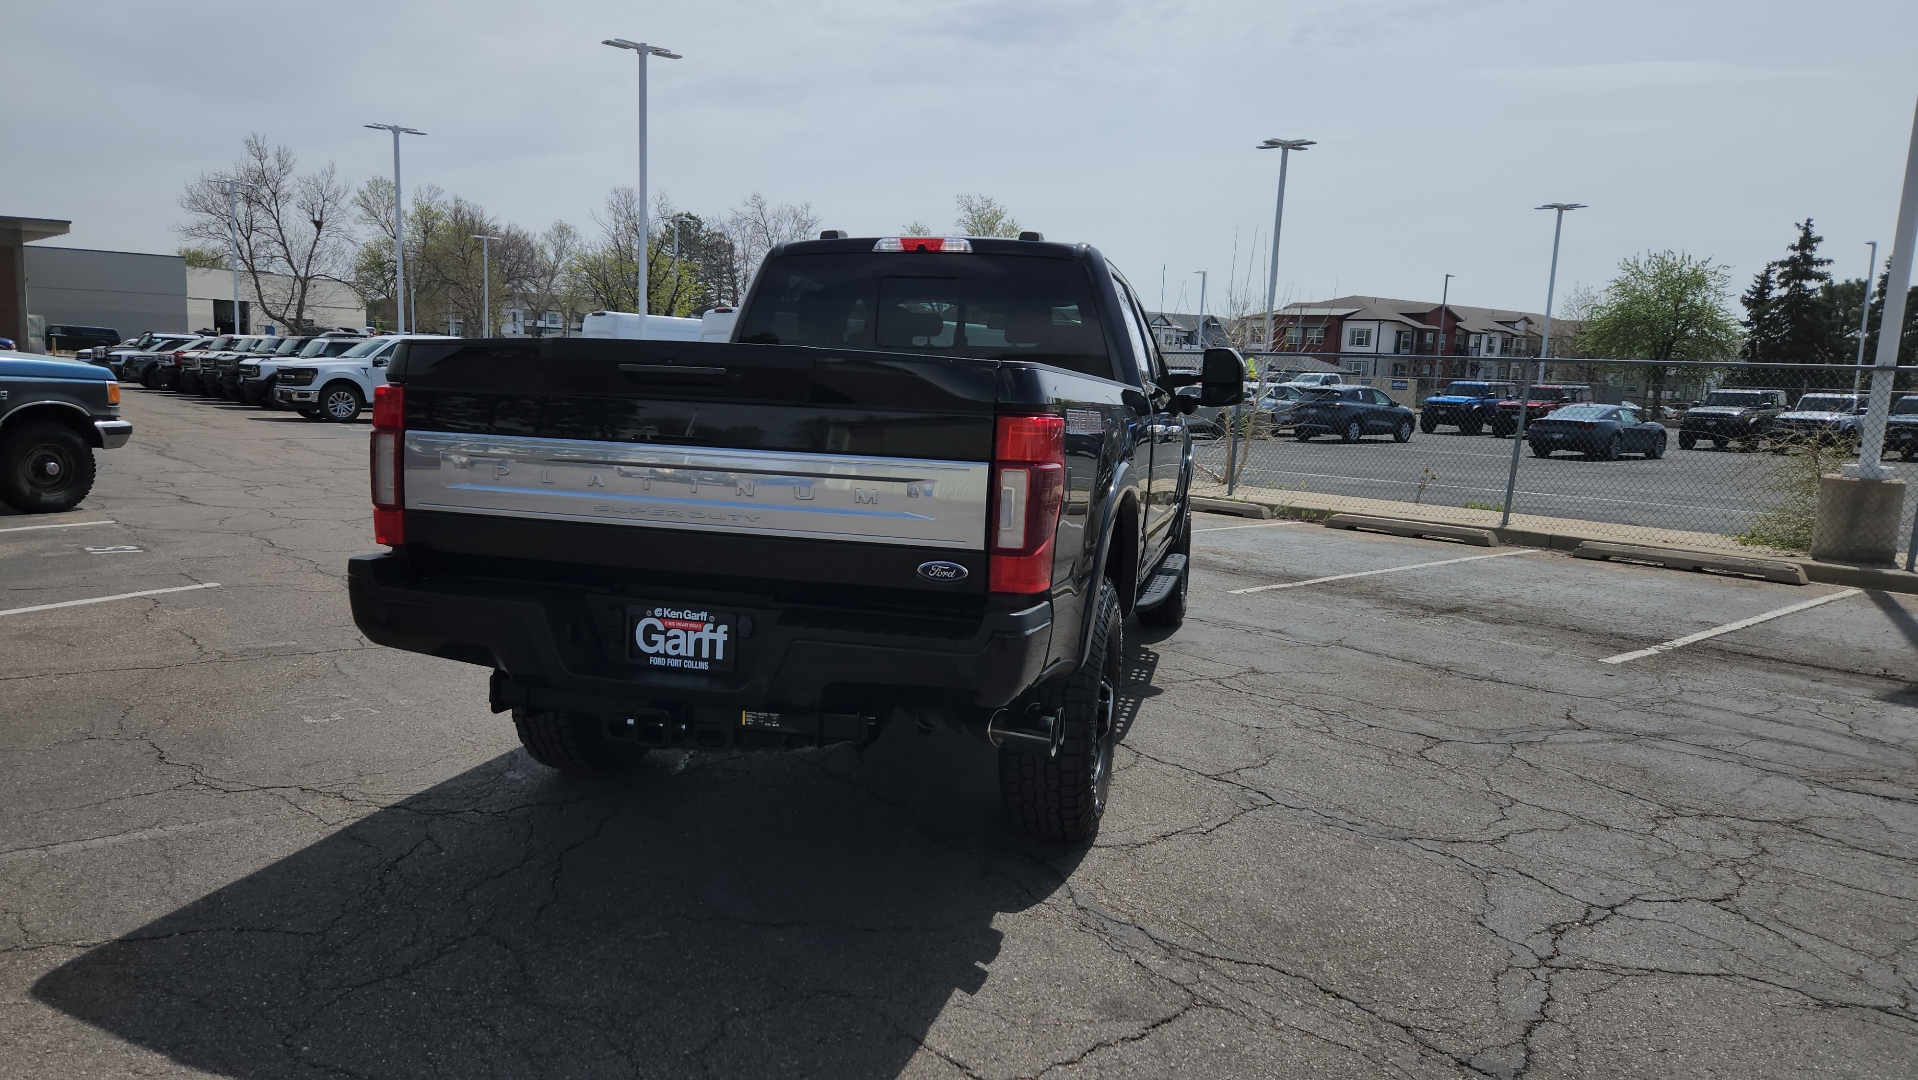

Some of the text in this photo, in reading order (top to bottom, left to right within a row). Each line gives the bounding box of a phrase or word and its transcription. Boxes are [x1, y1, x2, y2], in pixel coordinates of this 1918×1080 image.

[493, 465, 879, 504] PLATINUM
[594, 504, 761, 523] SUPER DUTY
[928, 564, 957, 578] Ford
[663, 607, 708, 621] Ken Garff
[635, 617, 728, 660] Garff
[649, 656, 709, 670] FORD FORT COLLINS
